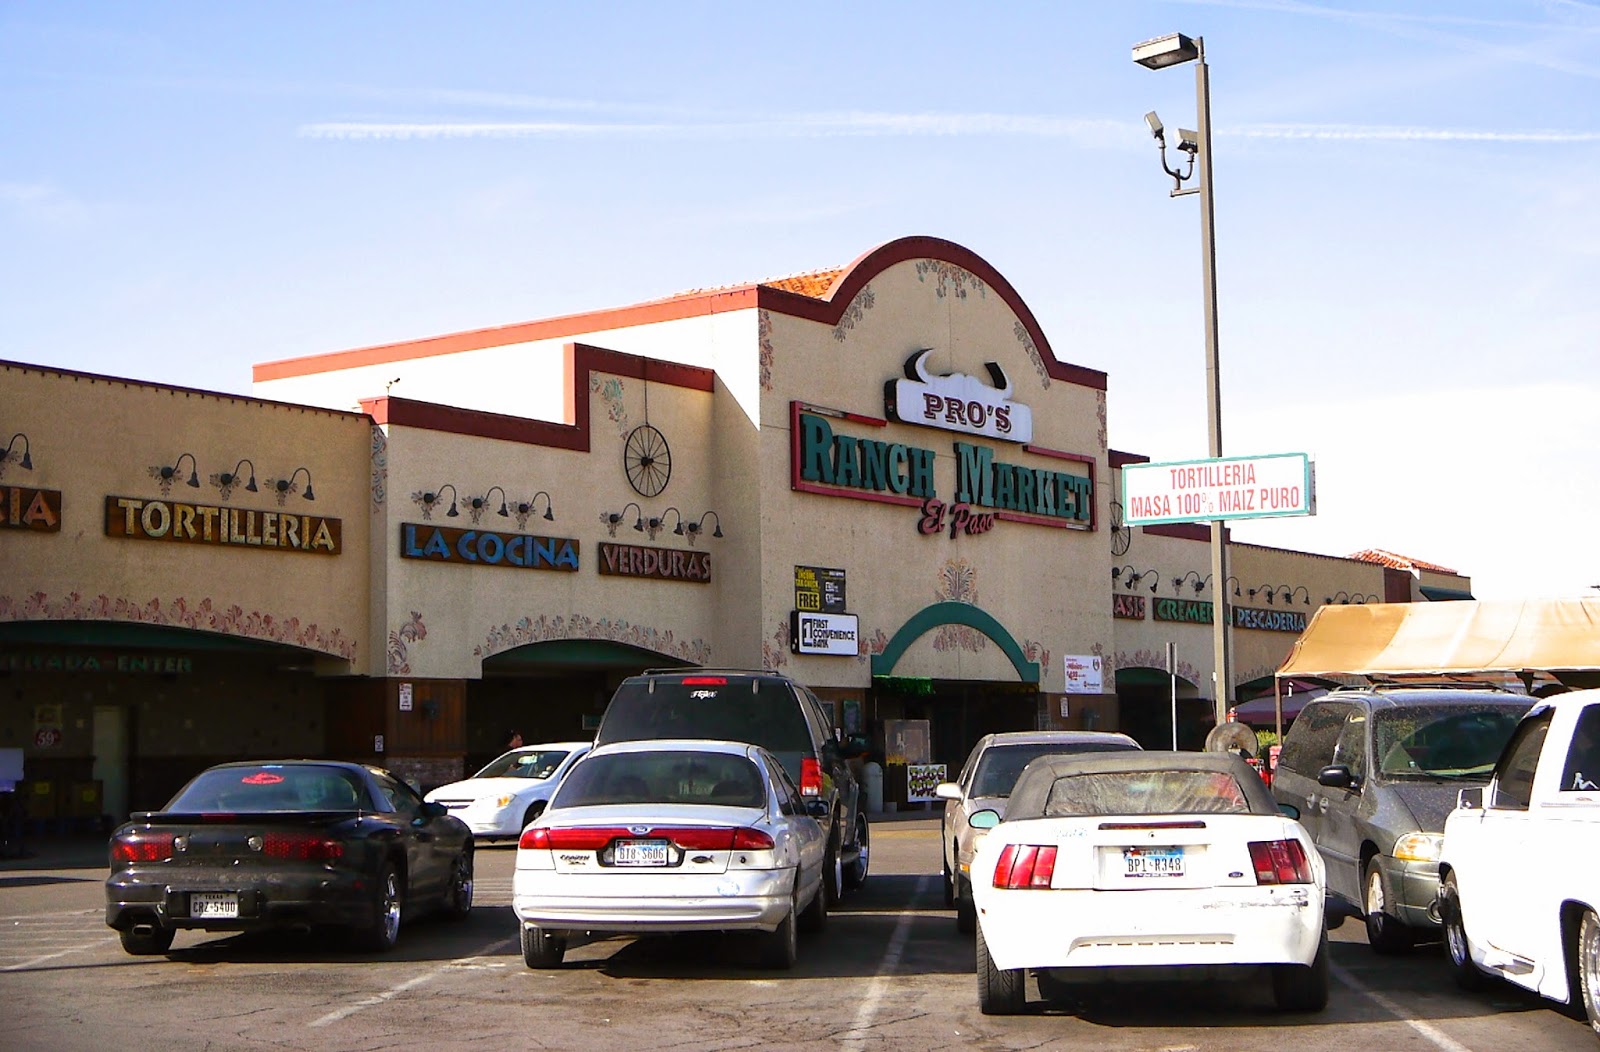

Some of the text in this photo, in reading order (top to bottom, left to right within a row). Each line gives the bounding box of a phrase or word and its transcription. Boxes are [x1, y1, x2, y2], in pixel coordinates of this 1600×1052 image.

[923, 392, 1011, 432] PRO'S
[800, 413, 1093, 520] RANCH MARKET
[1170, 463, 1256, 490] TORTILLERIA
[1131, 485, 1300, 518] MASA 100% MAIZ PURO
[118, 498, 335, 551] TORTILLERIA
[920, 498, 994, 540] El Paso
[405, 526, 578, 569] LA COCINA
[602, 545, 711, 580] VERDURAS
[799, 594, 818, 608] FREE
[1157, 599, 1232, 624] CREMER
[813, 619, 828, 628] FIRST
[813, 629, 855, 640] CONVENIENCE
[1237, 609, 1305, 632] PESCADERIA
[813, 639, 829, 648] BANK
